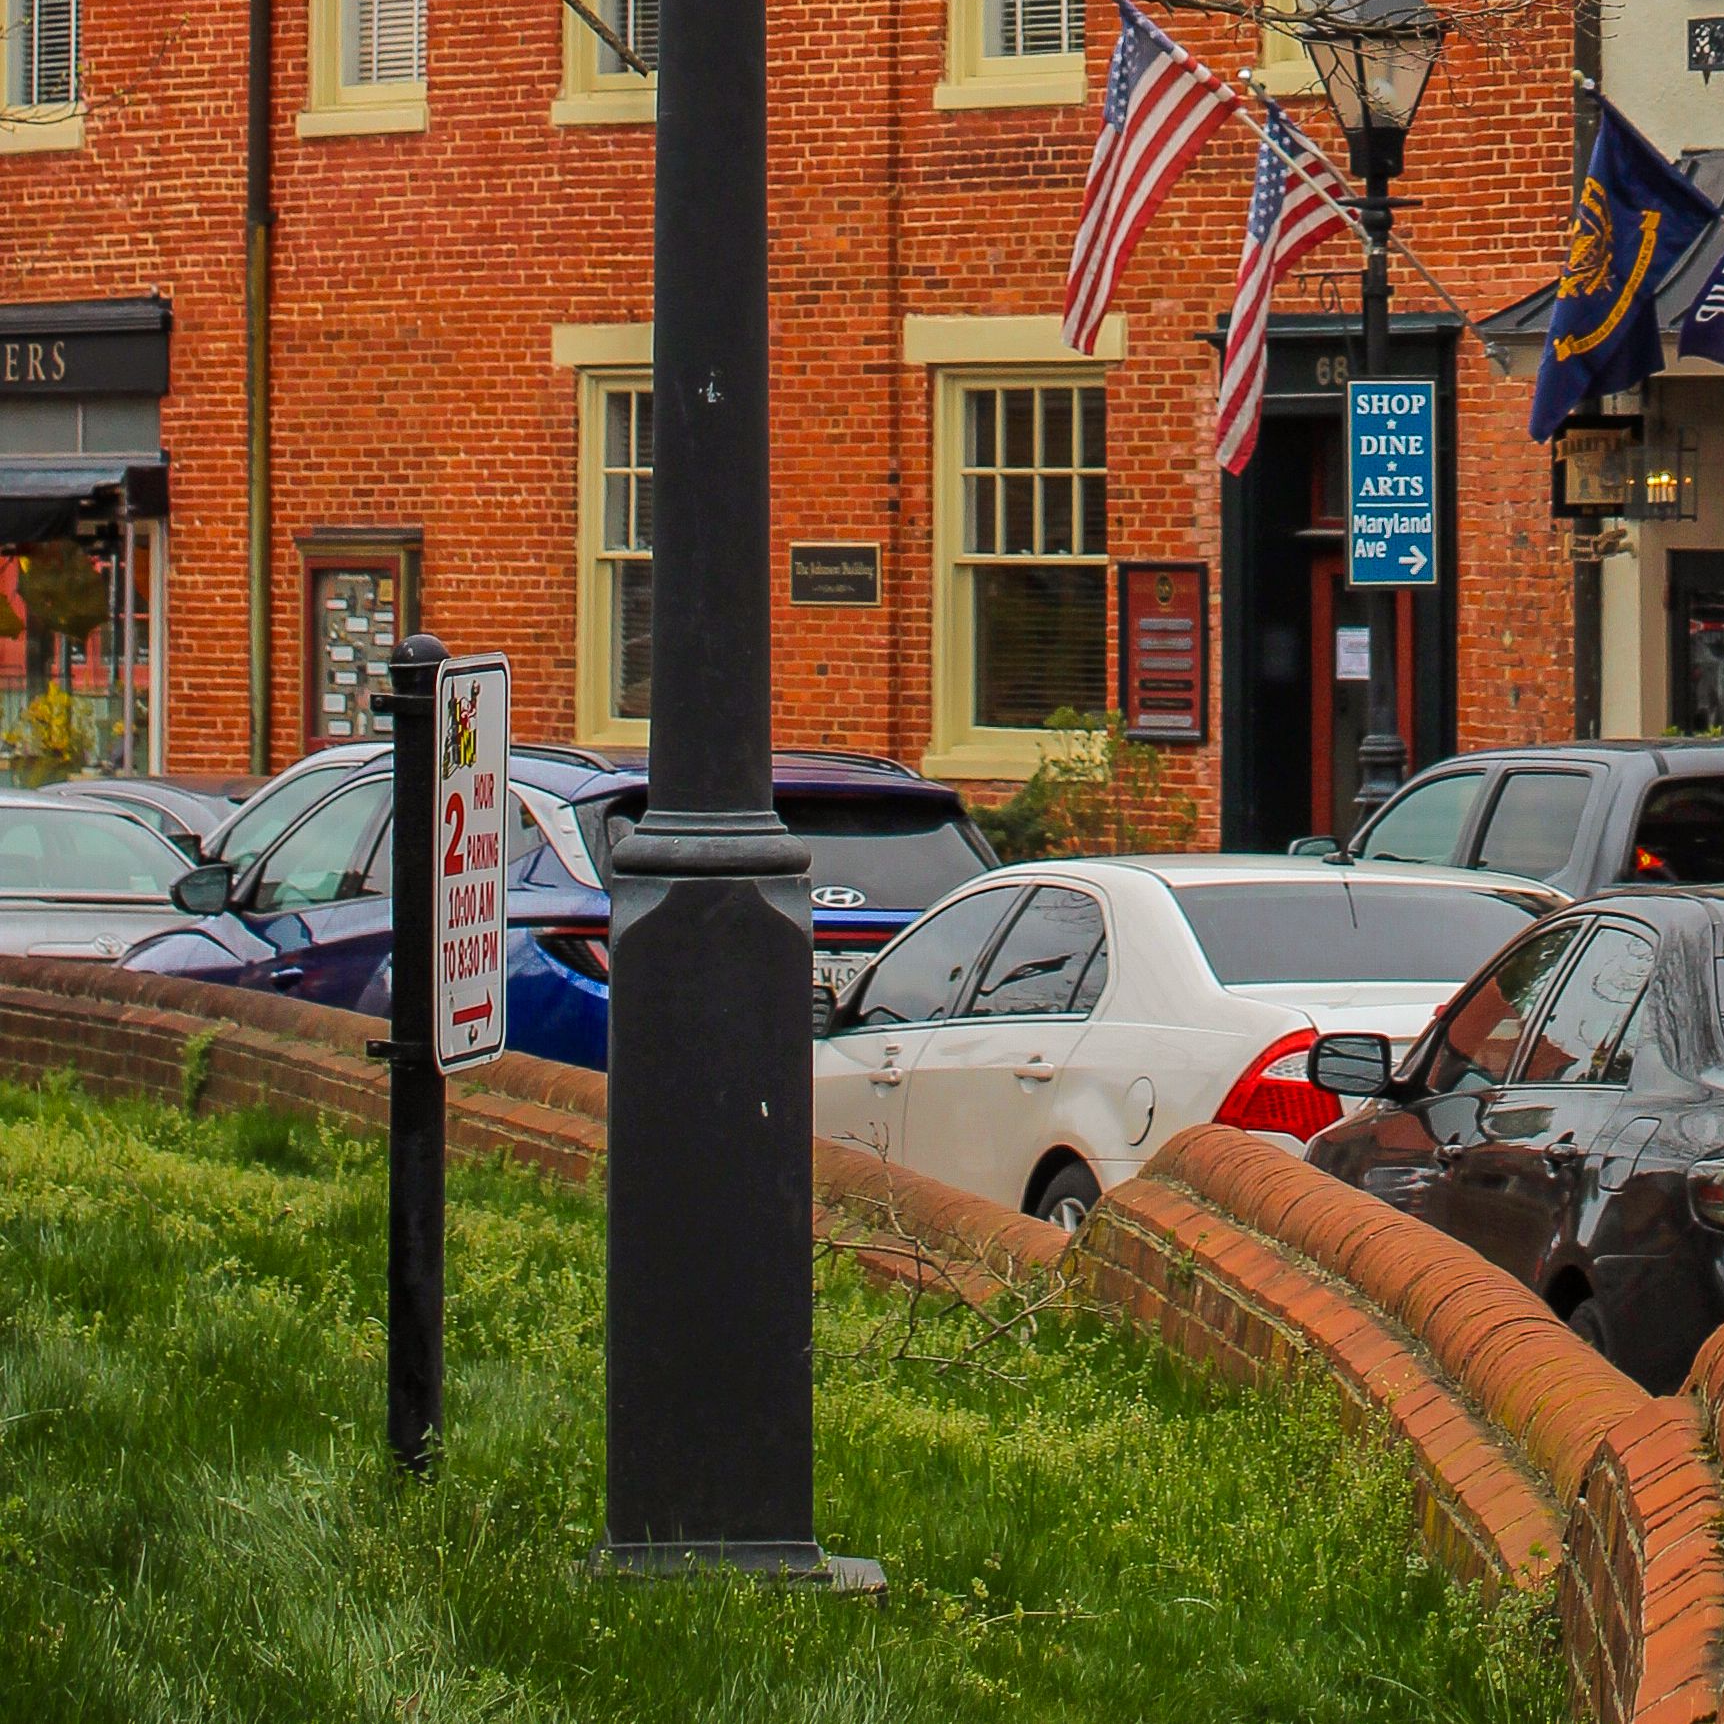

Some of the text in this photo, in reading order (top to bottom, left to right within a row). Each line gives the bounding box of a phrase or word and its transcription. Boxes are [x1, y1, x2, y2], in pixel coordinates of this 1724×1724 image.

[1356, 394, 1426, 415] SHOP
[1360, 435, 1425, 455] DINE
[1359, 476, 1424, 496] ARTS
[1353, 512, 1432, 539] Maryland
[1354, 538, 1388, 558] Ave
[444, 773, 495, 877] 2 HOUR
[466, 831, 499, 871] PARKING
[448, 880, 495, 930] 10:00 AM
[443, 930, 498, 984] TO 8:30 PM
